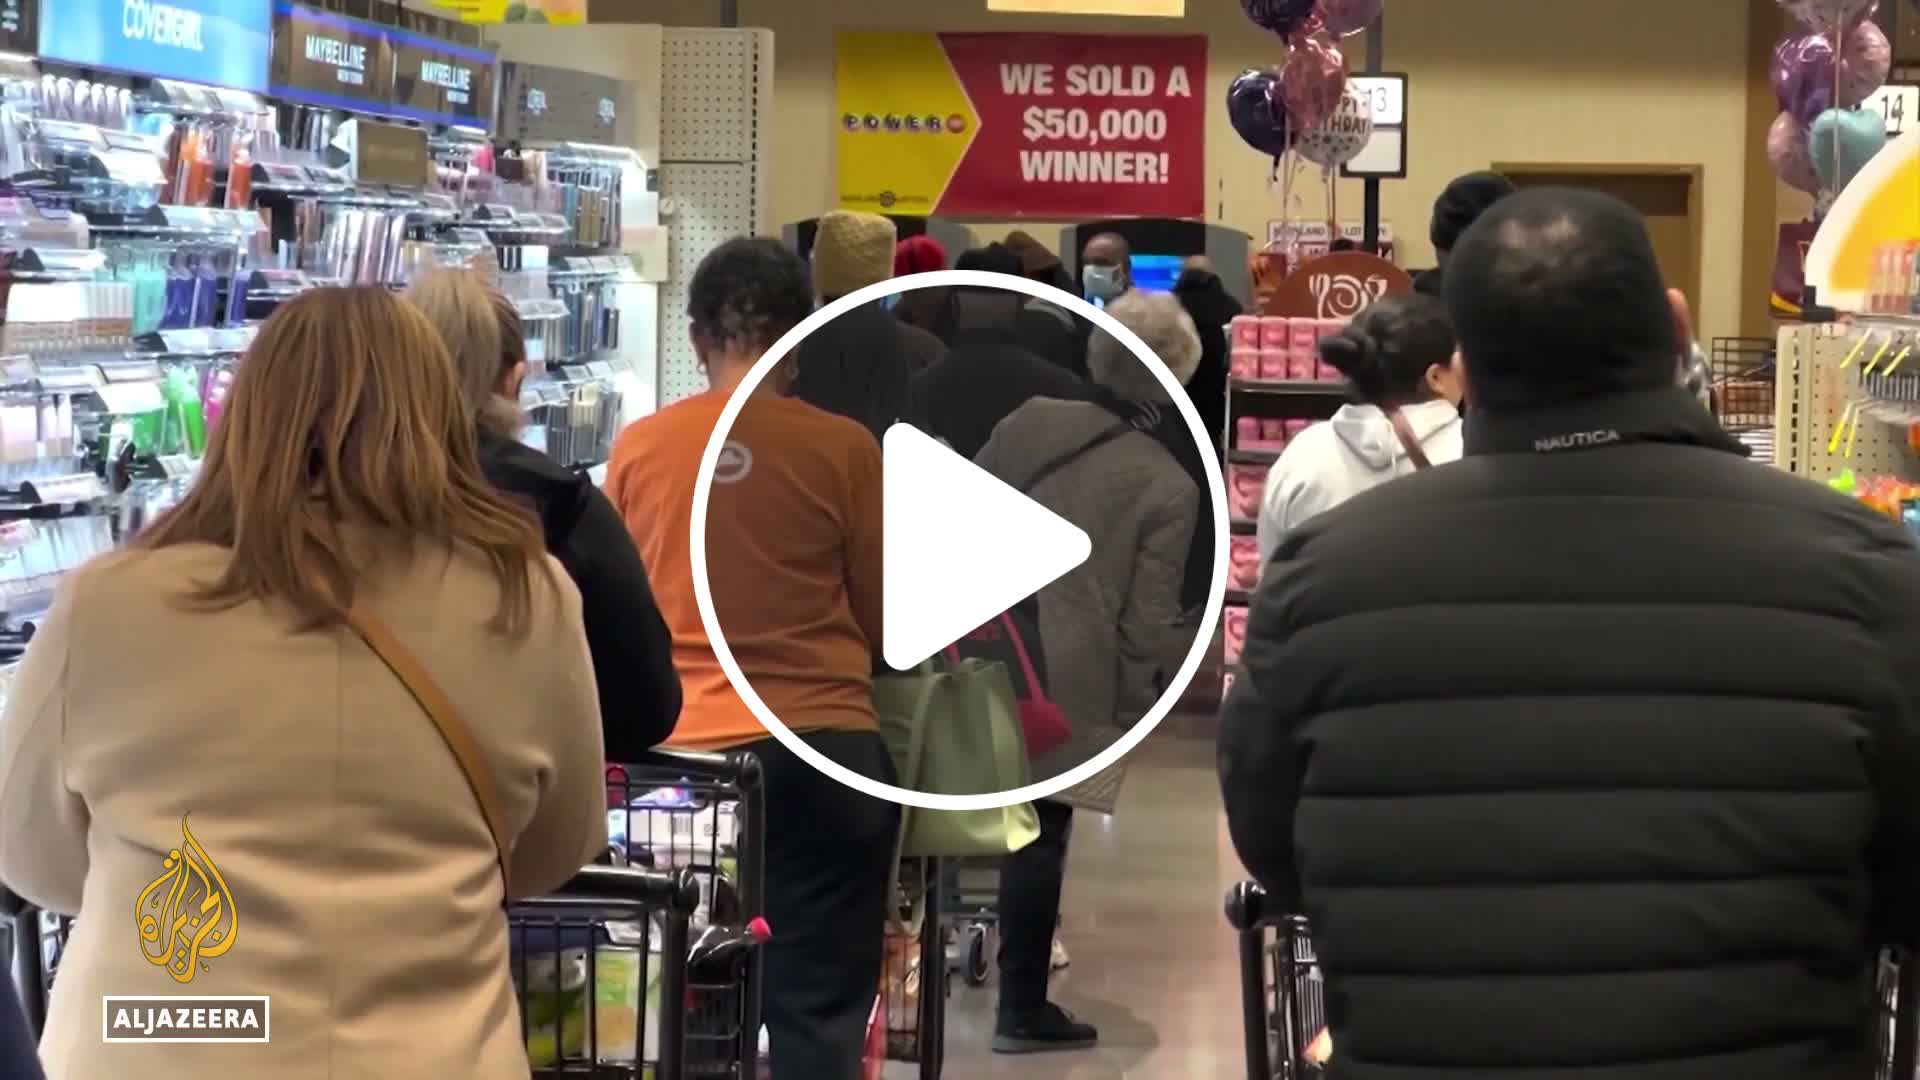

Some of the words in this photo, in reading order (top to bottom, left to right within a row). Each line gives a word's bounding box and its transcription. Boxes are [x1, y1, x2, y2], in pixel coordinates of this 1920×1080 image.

[122, 0, 204, 51] COVERGIRL
[305, 34, 366, 70] MAYBELLINE
[421, 60, 471, 91] MAYBELLINE
[1001, 64, 1054, 97] WE
[1066, 64, 1155, 97] SOLD
[1166, 65, 1191, 97] A
[1023, 106, 1167, 145] $50,000
[1881, 93, 1904, 131] 14
[1020, 151, 1169, 184] WINNER!
[1534, 429, 1620, 451] NAUTICA
